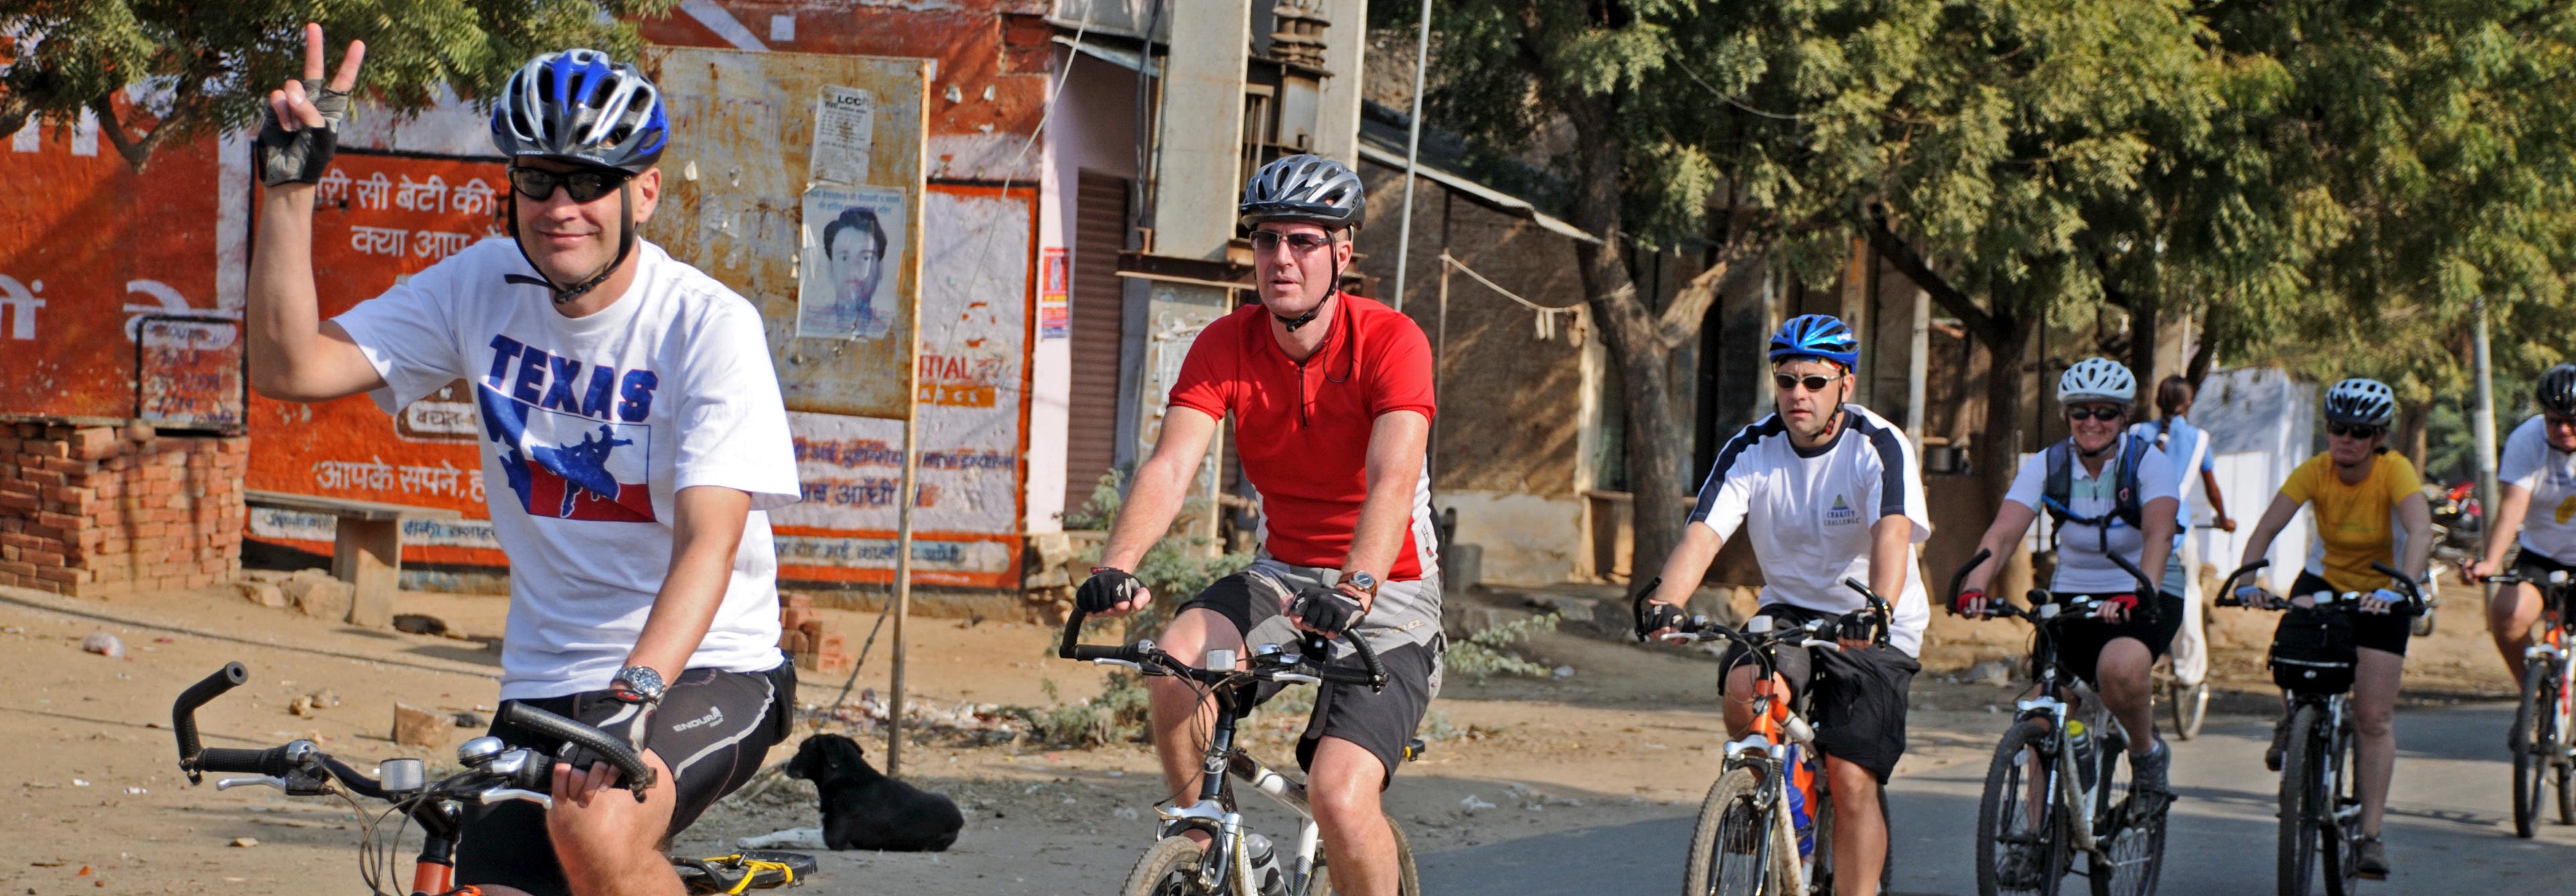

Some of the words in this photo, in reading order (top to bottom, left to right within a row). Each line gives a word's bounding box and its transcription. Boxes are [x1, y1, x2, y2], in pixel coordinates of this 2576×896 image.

[356, 171, 392, 210] सी
[396, 173, 447, 214] बेटी
[452, 178, 496, 215] की
[350, 225, 408, 258] क्या
[488, 333, 659, 423] TEXAS
